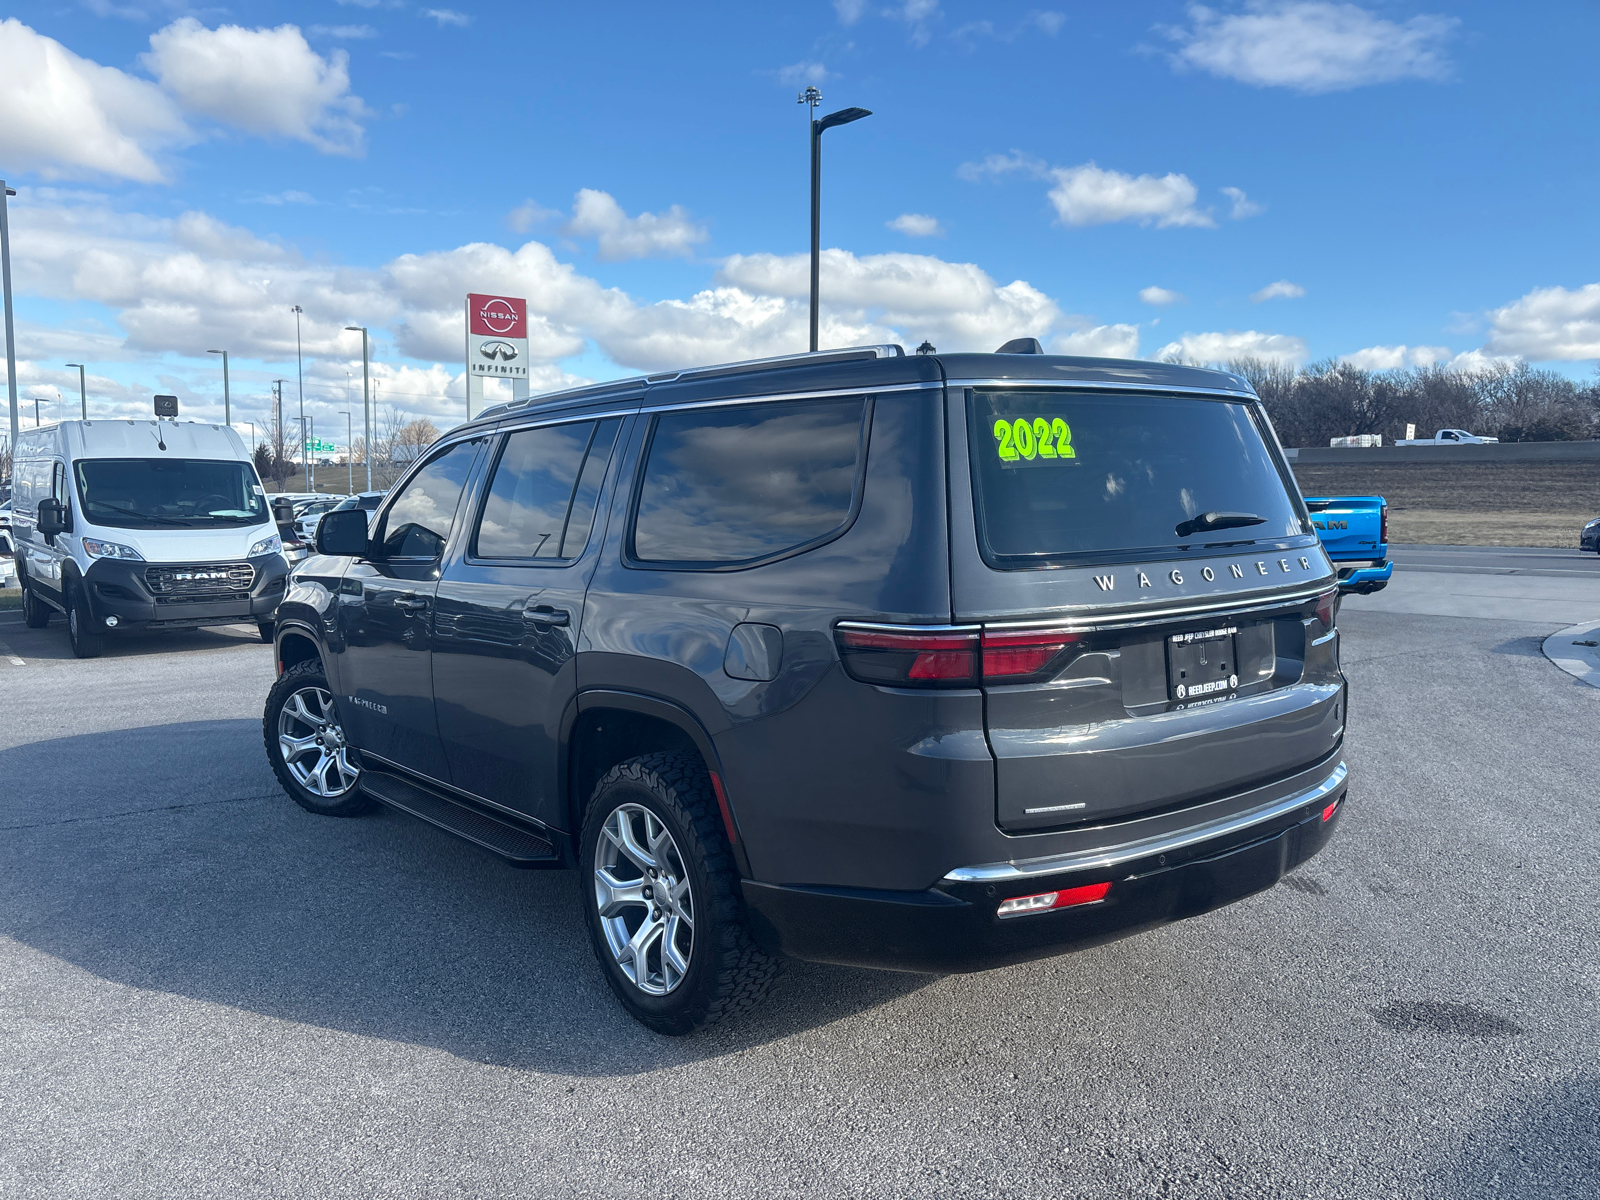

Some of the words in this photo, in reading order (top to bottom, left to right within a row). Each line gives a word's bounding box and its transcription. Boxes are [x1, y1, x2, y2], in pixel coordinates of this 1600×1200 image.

[480, 311, 518, 320] NISSAN
[473, 364, 526, 375] INFINITI
[993, 417, 1076, 462] 2022
[1313, 520, 1348, 530] AM
[176, 572, 227, 580] RAM
[1093, 556, 1311, 592] WAGONEER
[1172, 634, 1183, 642] REED
[1184, 633, 1194, 641] JEEP
[1195, 630, 1214, 639] CHRYSLER
[1215, 628, 1228, 636] DODGE
[1188, 679, 1228, 696] REEDJEEP.COM
